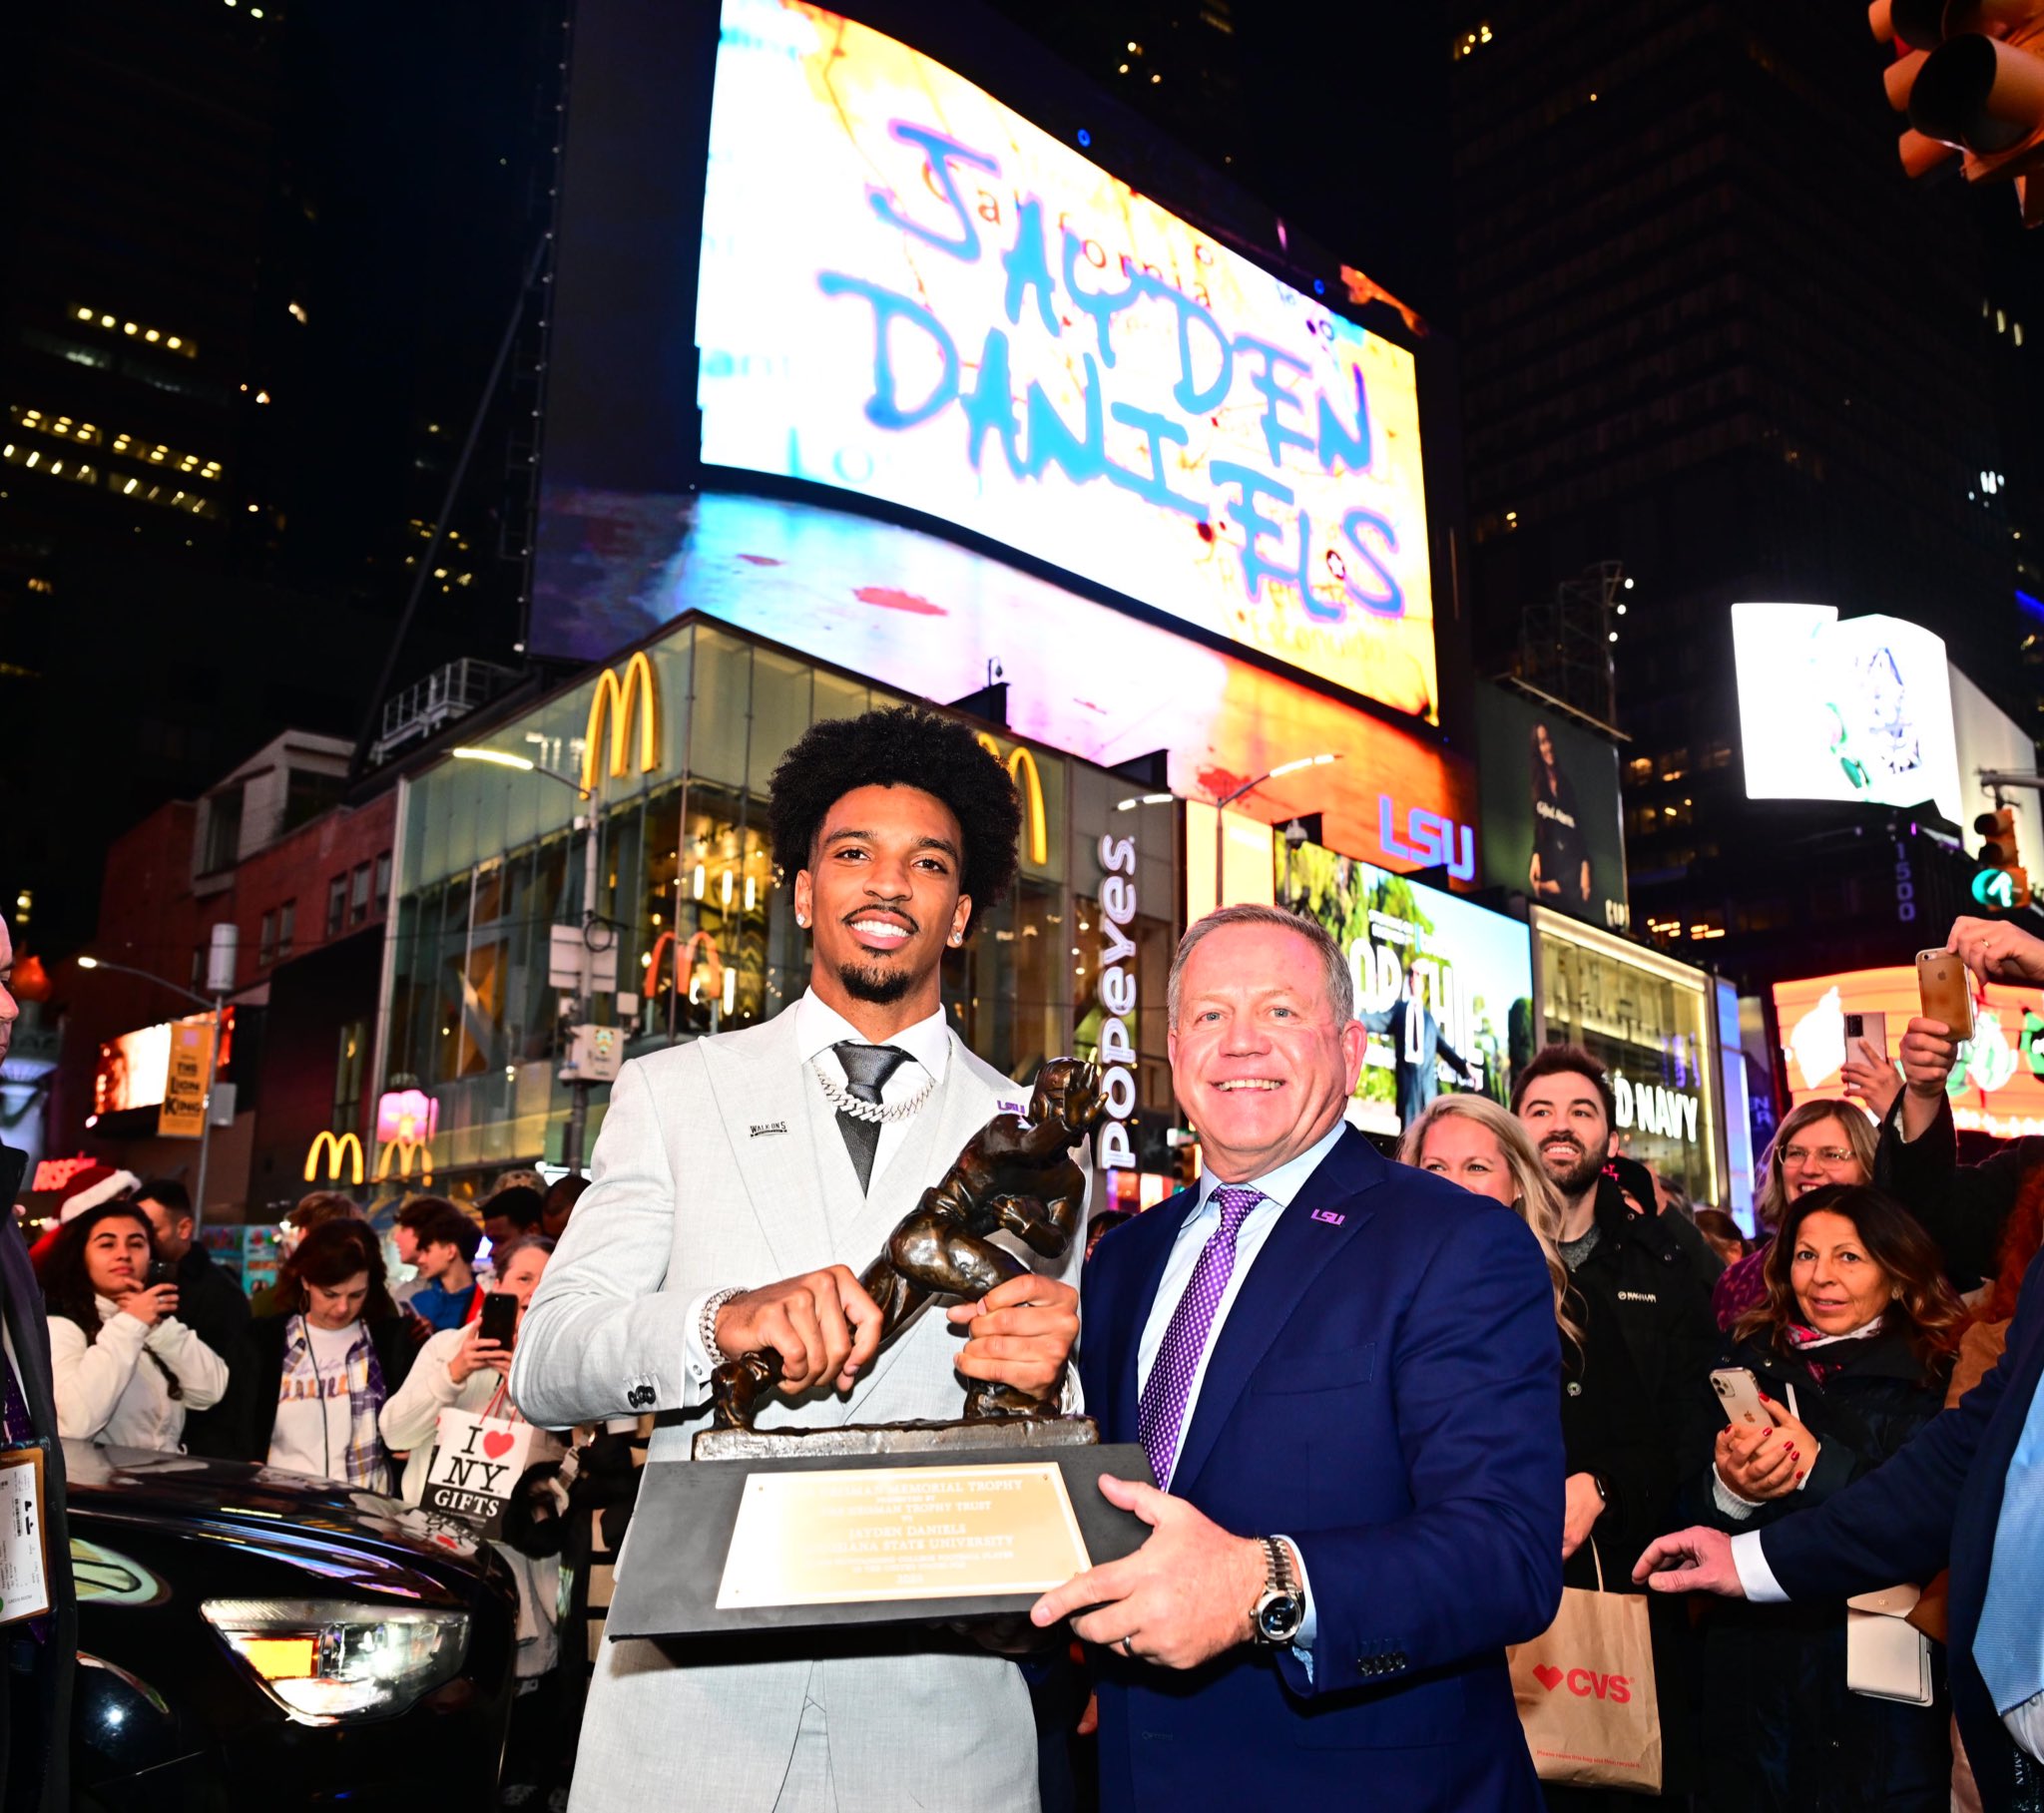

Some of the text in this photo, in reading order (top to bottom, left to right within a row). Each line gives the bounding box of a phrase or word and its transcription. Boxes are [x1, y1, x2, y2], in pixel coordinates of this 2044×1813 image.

[865, 118, 1372, 475] JAYDEN
[815, 269, 1405, 624] DANIELS
[1378, 794, 1475, 882] LSU
[1635, 1082, 1698, 1142] NAVY
[1310, 1208, 1346, 1226] LSU
[460, 1425, 483, 1455] I
[442, 1456, 510, 1493] NY
[968, 1479, 1023, 1493] TROPHY
[433, 1489, 499, 1517] GIFTS
[905, 1502, 954, 1513] TROPHY
[957, 1500, 992, 1511] TRUST
[849, 1523, 967, 1540] JAYDEN DANIELS
[884, 1538, 924, 1551] STATE
[928, 1535, 1015, 1549] UNIVERSITY
[1567, 1667, 1631, 1704] CVS
